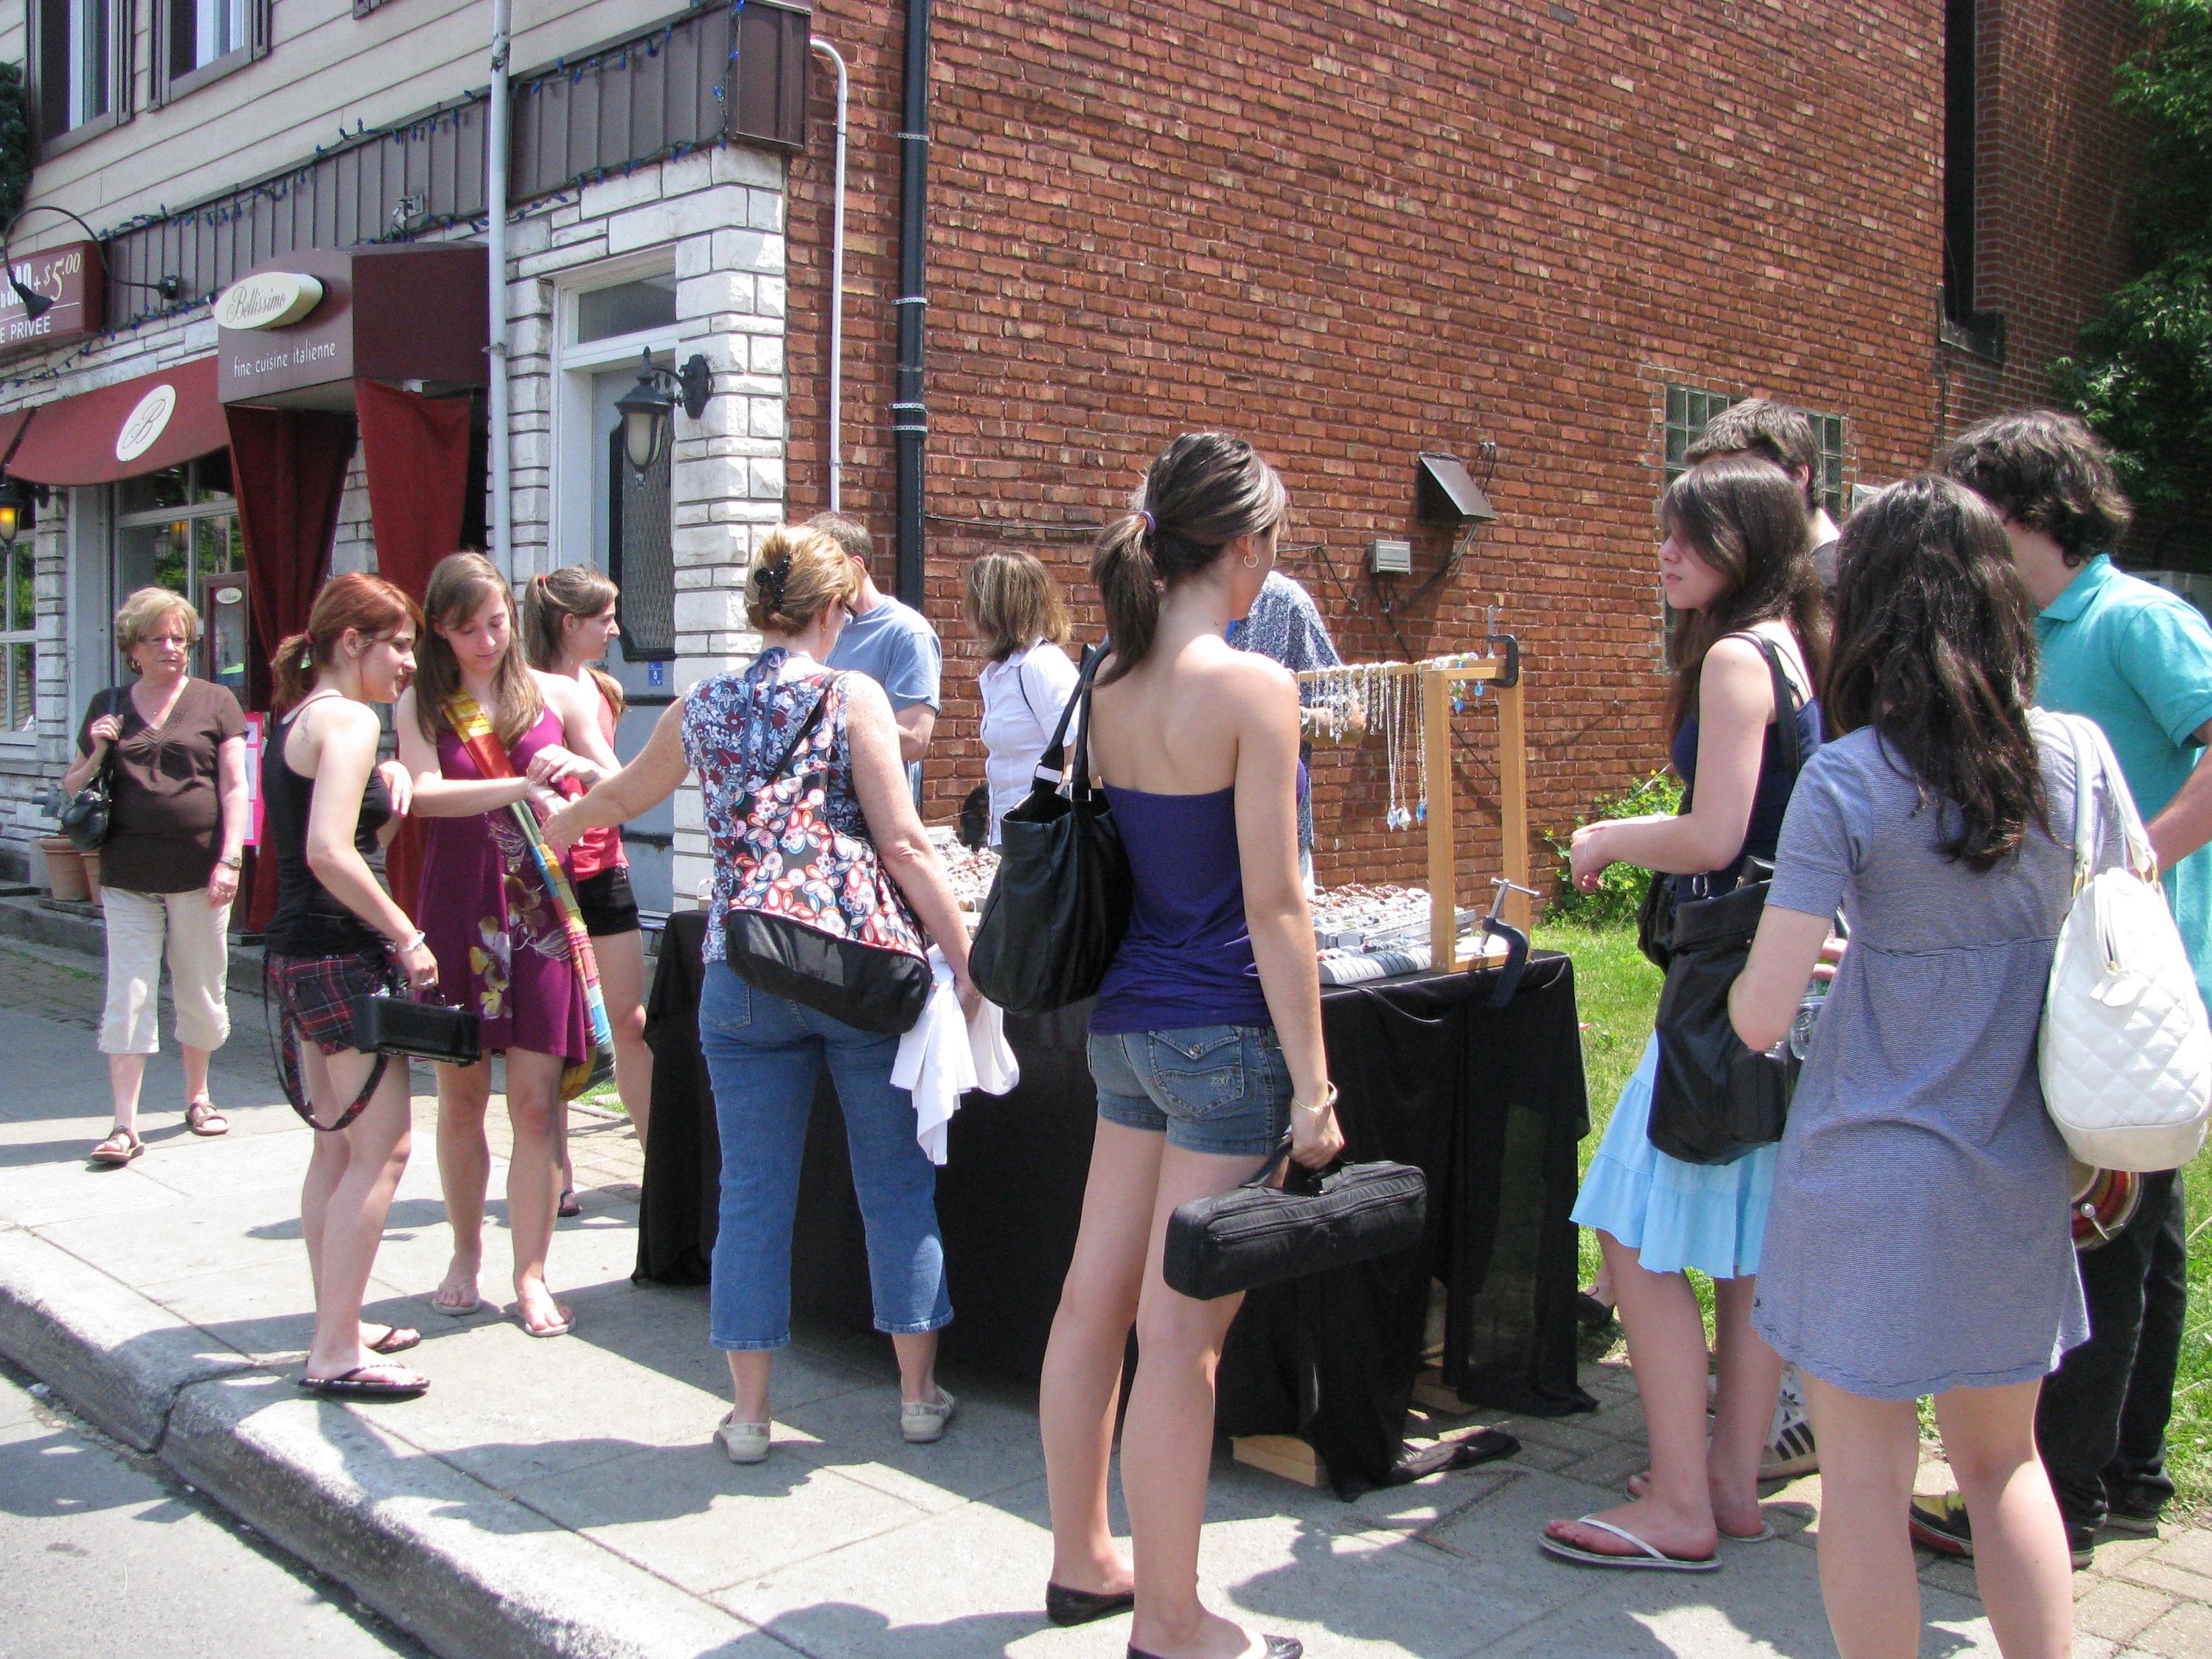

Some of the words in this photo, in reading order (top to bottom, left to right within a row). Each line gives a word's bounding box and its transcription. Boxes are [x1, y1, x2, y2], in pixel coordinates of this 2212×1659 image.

[226, 285, 286, 323] Bellissimo
[10, 316, 51, 341] PRIVEE
[234, 355, 251, 378] fine
[255, 350, 288, 373] cuisine
[293, 338, 336, 365] italienne
